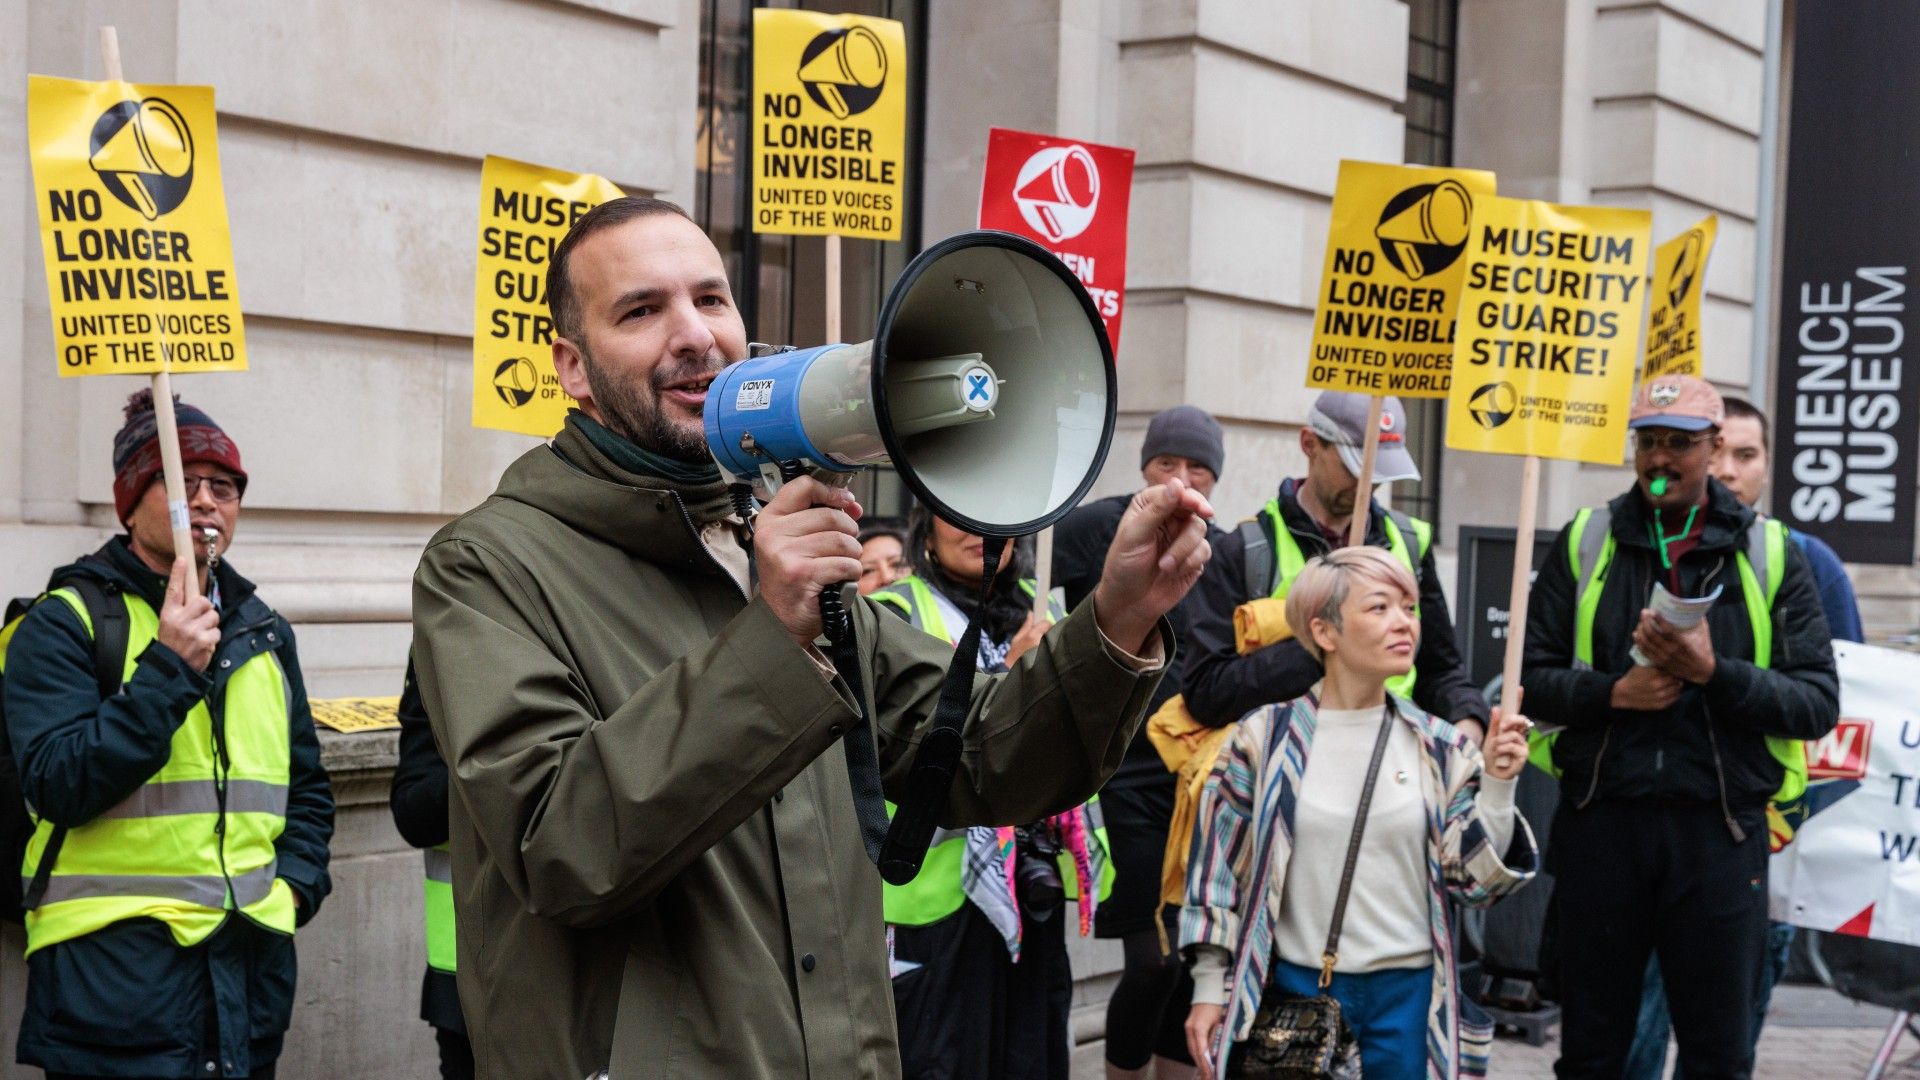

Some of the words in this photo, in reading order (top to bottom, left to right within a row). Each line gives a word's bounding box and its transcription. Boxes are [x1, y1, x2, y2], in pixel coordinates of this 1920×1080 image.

[764, 94, 801, 118] NO
[764, 124, 873, 153] LONGER
[763, 154, 896, 185] INVISIBLE
[49, 189, 102, 222] NO
[493, 188, 597, 227] MUSE
[760, 188, 827, 205] UNITED
[833, 191, 893, 211] VOICES
[760, 210, 783, 225] OF
[789, 211, 826, 226] THE
[833, 212, 892, 232] WORLD
[53, 229, 193, 262] LONGER
[1481, 225, 1633, 265] MUSEUM
[1333, 248, 1376, 276] NO
[60, 268, 229, 302] INVISIBLE
[495, 270, 549, 303] GU
[1327, 278, 1446, 314] LONGER
[1468, 262, 1639, 303] SECURITY
[61, 314, 151, 337] UNITED
[156, 314, 231, 334] VOICES
[1477, 301, 1619, 339] GUARDS
[65, 345, 98, 367] OF
[106, 343, 156, 363] THE
[159, 342, 235, 362] WORLD
[1315, 344, 1387, 367] UNITED
[1469, 338, 1609, 376] STRIKE!
[541, 388, 558, 399] OF
[742, 380, 773, 391] VONYX
[1312, 366, 1339, 383] OF
[1344, 369, 1384, 389] THE
[1388, 373, 1451, 392] WORLD
[1844, 266, 1906, 522] MUSEUM
[1520, 396, 1562, 410] UNITED
[1565, 401, 1608, 414] VOICES
[1790, 281, 1851, 523] SCIENCE
[1519, 408, 1533, 420] OF
[1538, 410, 1560, 423] THE
[1563, 414, 1608, 428] WORLD
[1879, 830, 1920, 863] W
